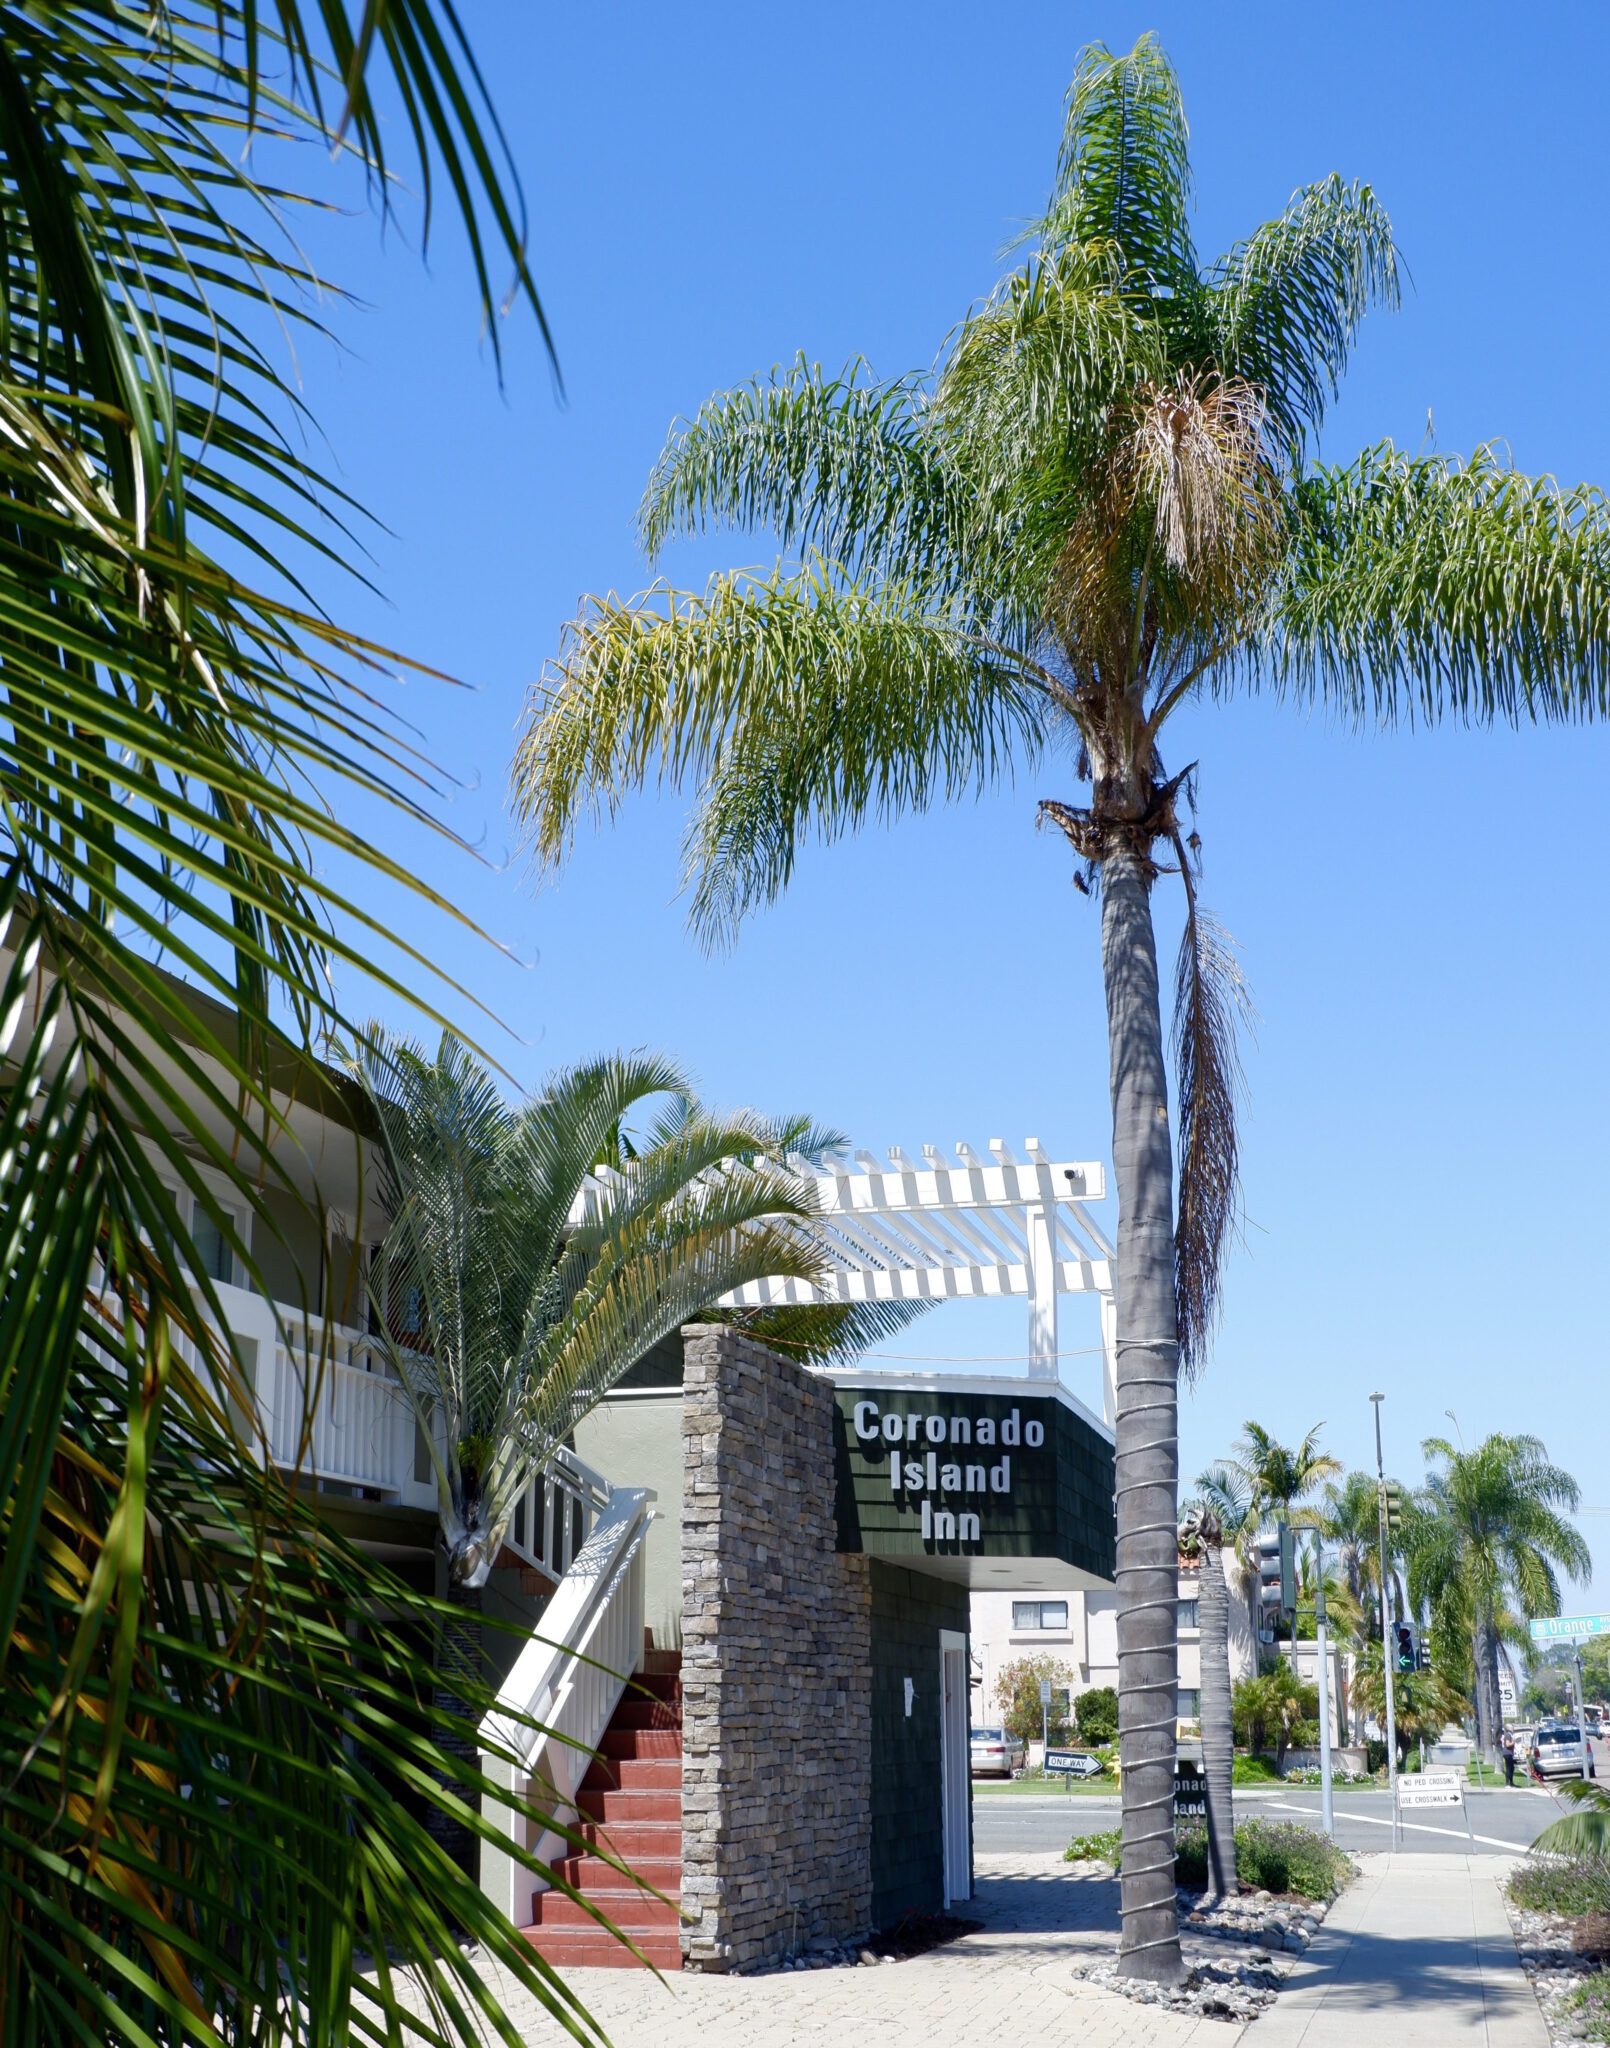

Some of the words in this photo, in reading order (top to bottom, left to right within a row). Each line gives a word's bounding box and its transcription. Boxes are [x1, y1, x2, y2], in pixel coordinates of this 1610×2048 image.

[853, 1400, 1045, 1448] Coronado
[890, 1450, 1011, 1493] Island
[921, 1500, 980, 1541] Inn
[1550, 1619, 1593, 1633] Orange
[1050, 1757, 1067, 1767] ONE
[1069, 1758, 1086, 1768] WAY
[1403, 1778, 1412, 1787] NO
[1414, 1778, 1427, 1786] PED
[1429, 1777, 1455, 1785] CROSSING
[1174, 1799, 1206, 1815] land
[1400, 1796, 1412, 1805] USE
[1414, 1795, 1448, 1804] CROSSWALK
